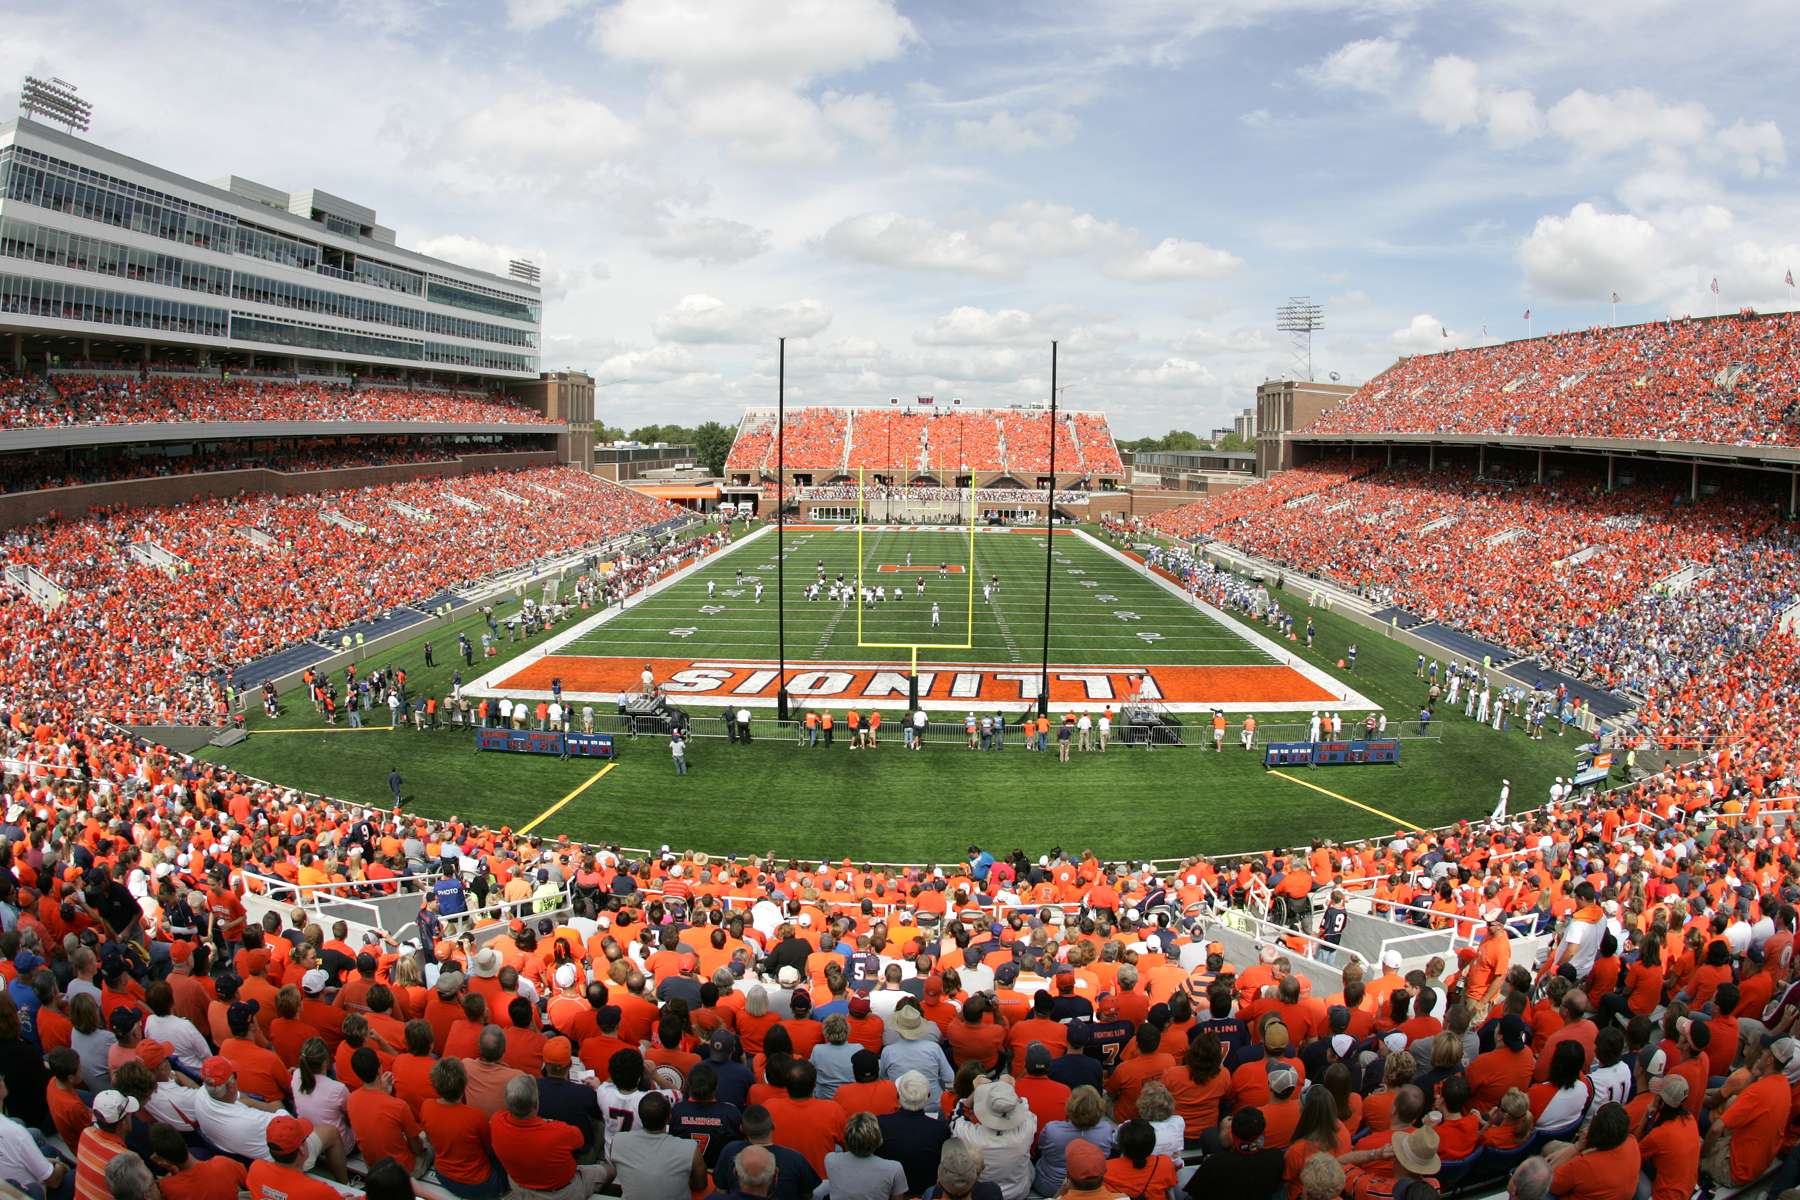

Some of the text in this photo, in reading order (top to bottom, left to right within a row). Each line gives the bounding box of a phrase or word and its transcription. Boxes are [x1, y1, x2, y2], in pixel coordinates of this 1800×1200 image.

[437, 887, 459, 896] PHOTO
[1334, 913, 1345, 932] 9
[854, 962, 866, 981] 5
[1102, 1042, 1120, 1066] 7
[607, 1106, 634, 1133] 7
